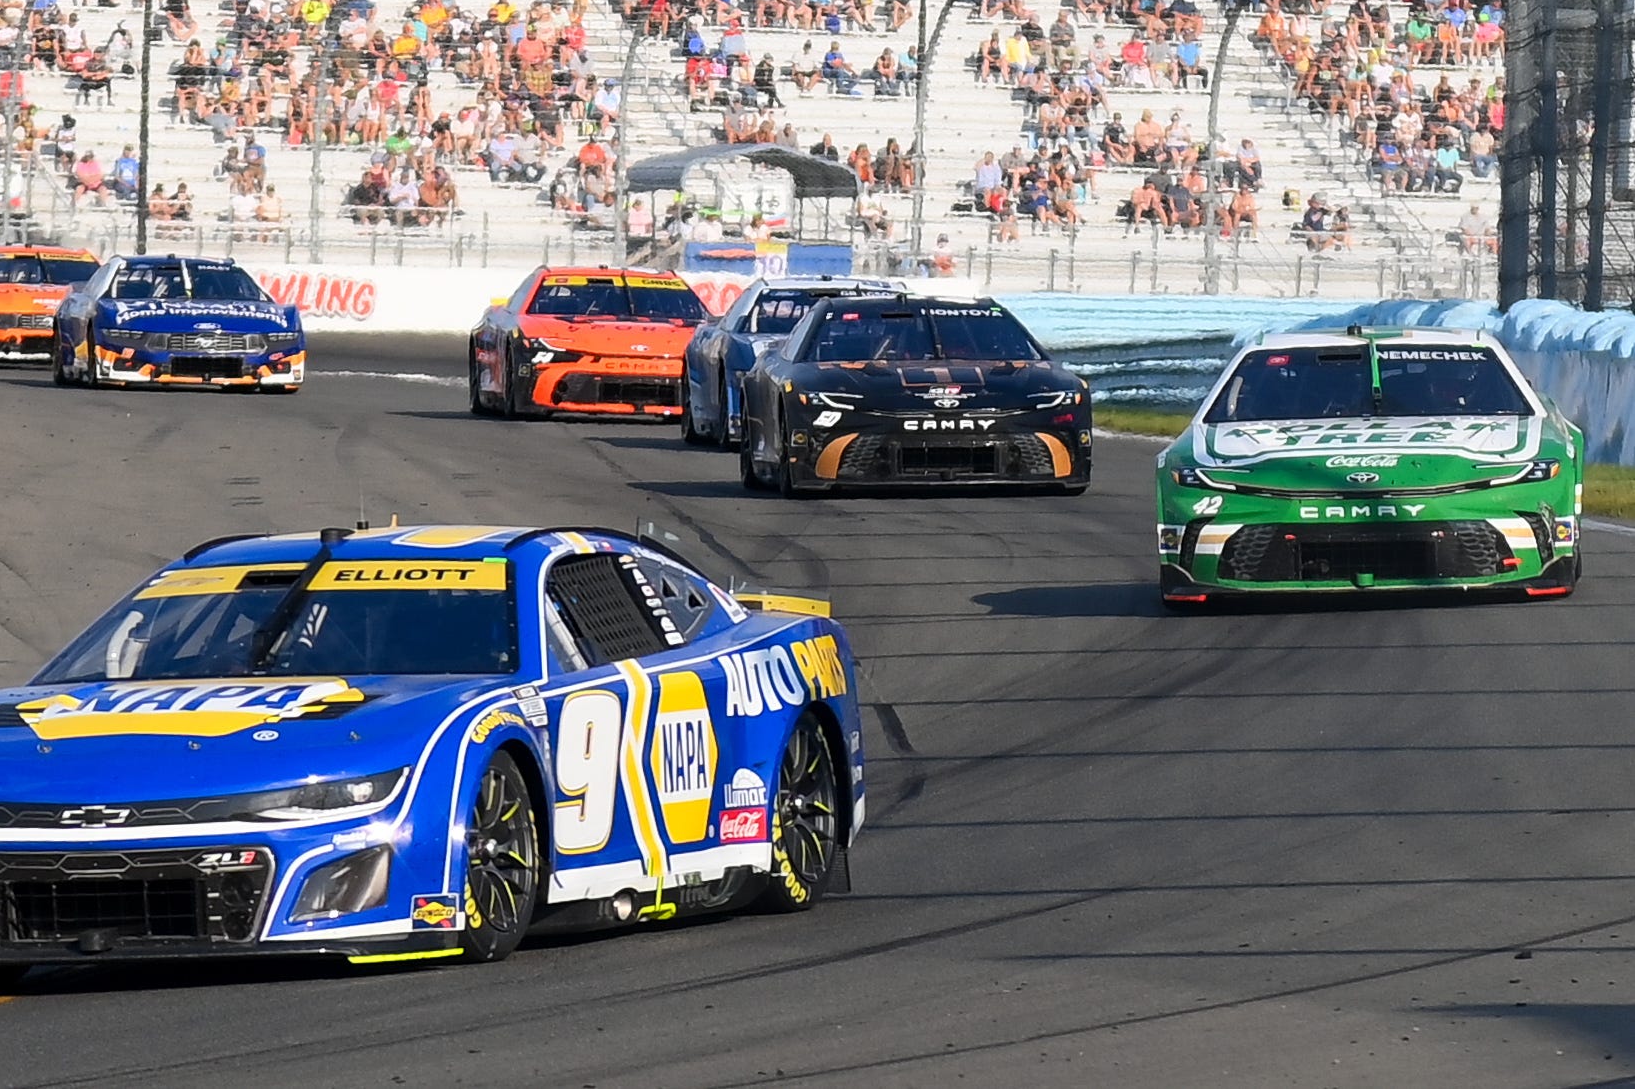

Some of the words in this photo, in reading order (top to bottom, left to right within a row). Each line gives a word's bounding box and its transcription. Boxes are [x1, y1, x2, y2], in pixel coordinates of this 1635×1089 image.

[259, 272, 375, 317] WLING
[1375, 350, 1488, 361] NEMECHEK
[903, 419, 996, 431] CAMRY
[1278, 431, 1452, 447] TREE
[1192, 495, 1224, 515] 42
[1299, 504, 1426, 519] CAMRY
[333, 568, 477, 582] ELLIOTT
[717, 644, 805, 717] AUTO
[789, 634, 847, 701] PARTS
[56, 685, 314, 714] NAPA
[470, 708, 526, 744] GOODYEAR
[662, 719, 708, 794] NAPA
[553, 689, 622, 855] 9
[413, 900, 456, 919] SUNOCO
